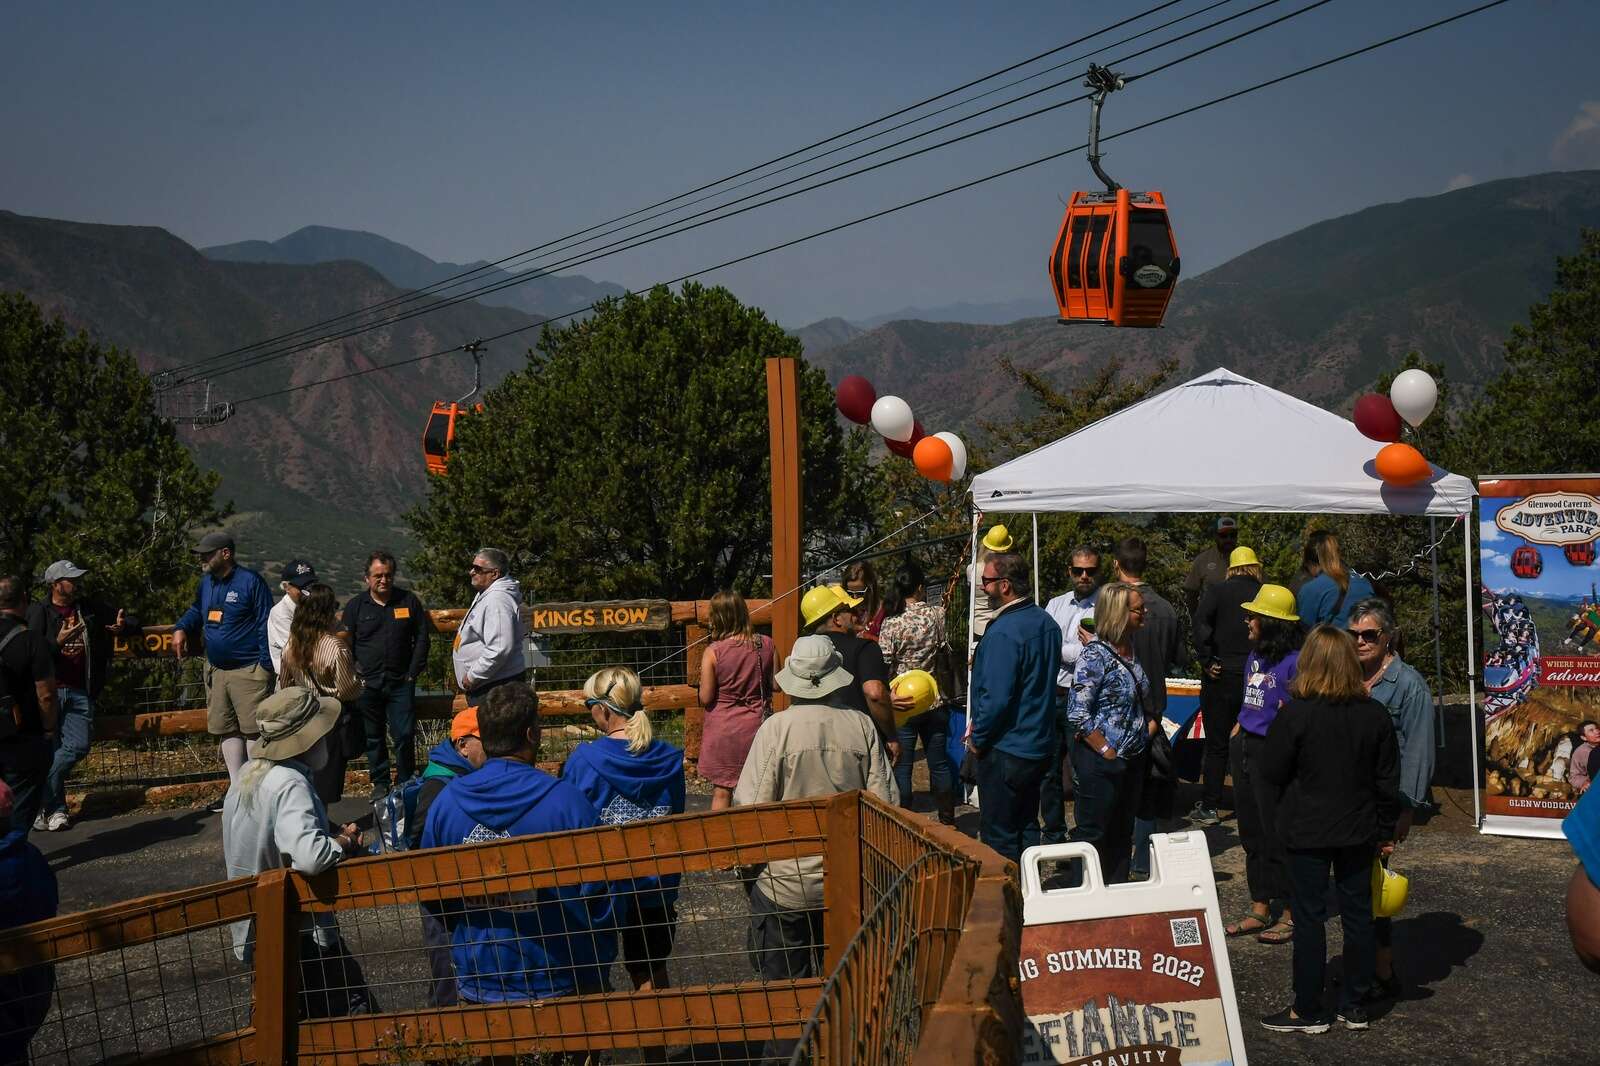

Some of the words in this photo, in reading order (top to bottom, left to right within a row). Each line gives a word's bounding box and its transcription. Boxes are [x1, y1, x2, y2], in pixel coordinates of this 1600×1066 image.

[1528, 500, 1561, 509] Glenwood
[1563, 500, 1592, 509] Caverns
[1511, 509, 1600, 528] ADVENTUR
[1560, 524, 1594, 536] PARK
[533, 608, 596, 628] KINGS
[602, 607, 649, 626] ROW
[1546, 660, 1574, 668] WHERE
[1047, 948, 1142, 974] SUMMER
[1151, 953, 1205, 987] 2022
